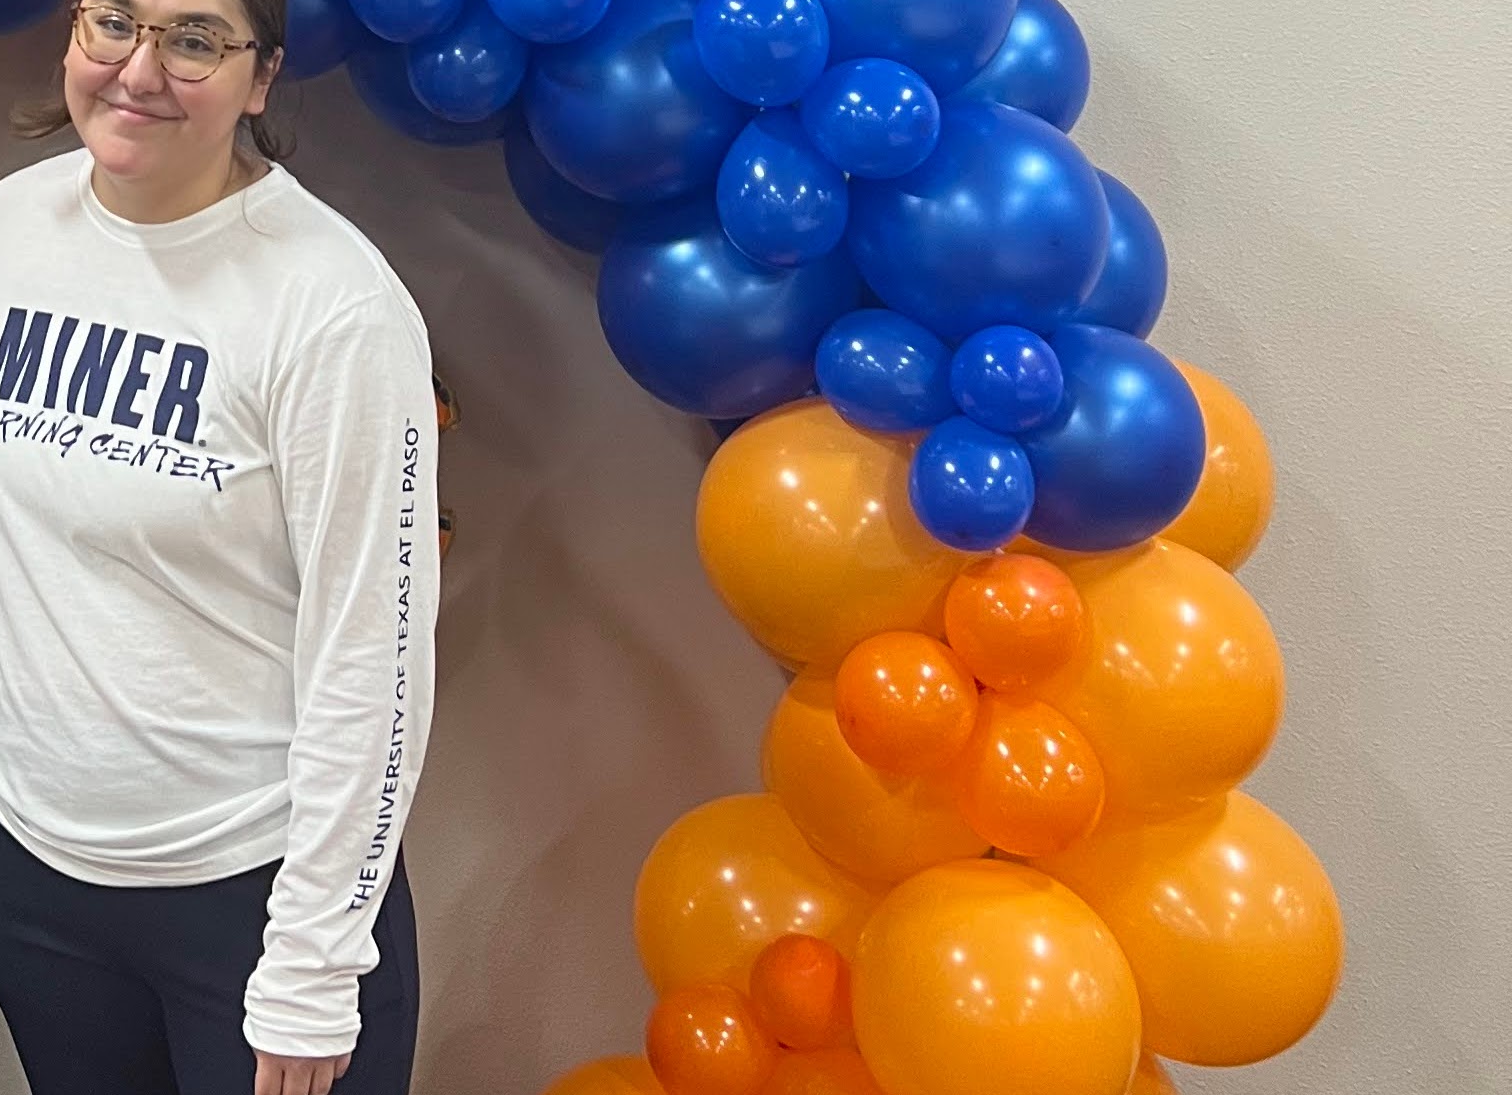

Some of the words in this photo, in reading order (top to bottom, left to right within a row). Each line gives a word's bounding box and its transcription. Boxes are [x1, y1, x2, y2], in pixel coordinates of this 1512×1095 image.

[90, 434, 235, 492] CENTER
[402, 427, 419, 492] PASO
[400, 500, 414, 529] EL
[399, 537, 412, 567] AT
[397, 575, 411, 658] TEXAS
[396, 665, 405, 700] OF
[367, 708, 405, 860] UNIVERSITY
[346, 868, 378, 914] THE
